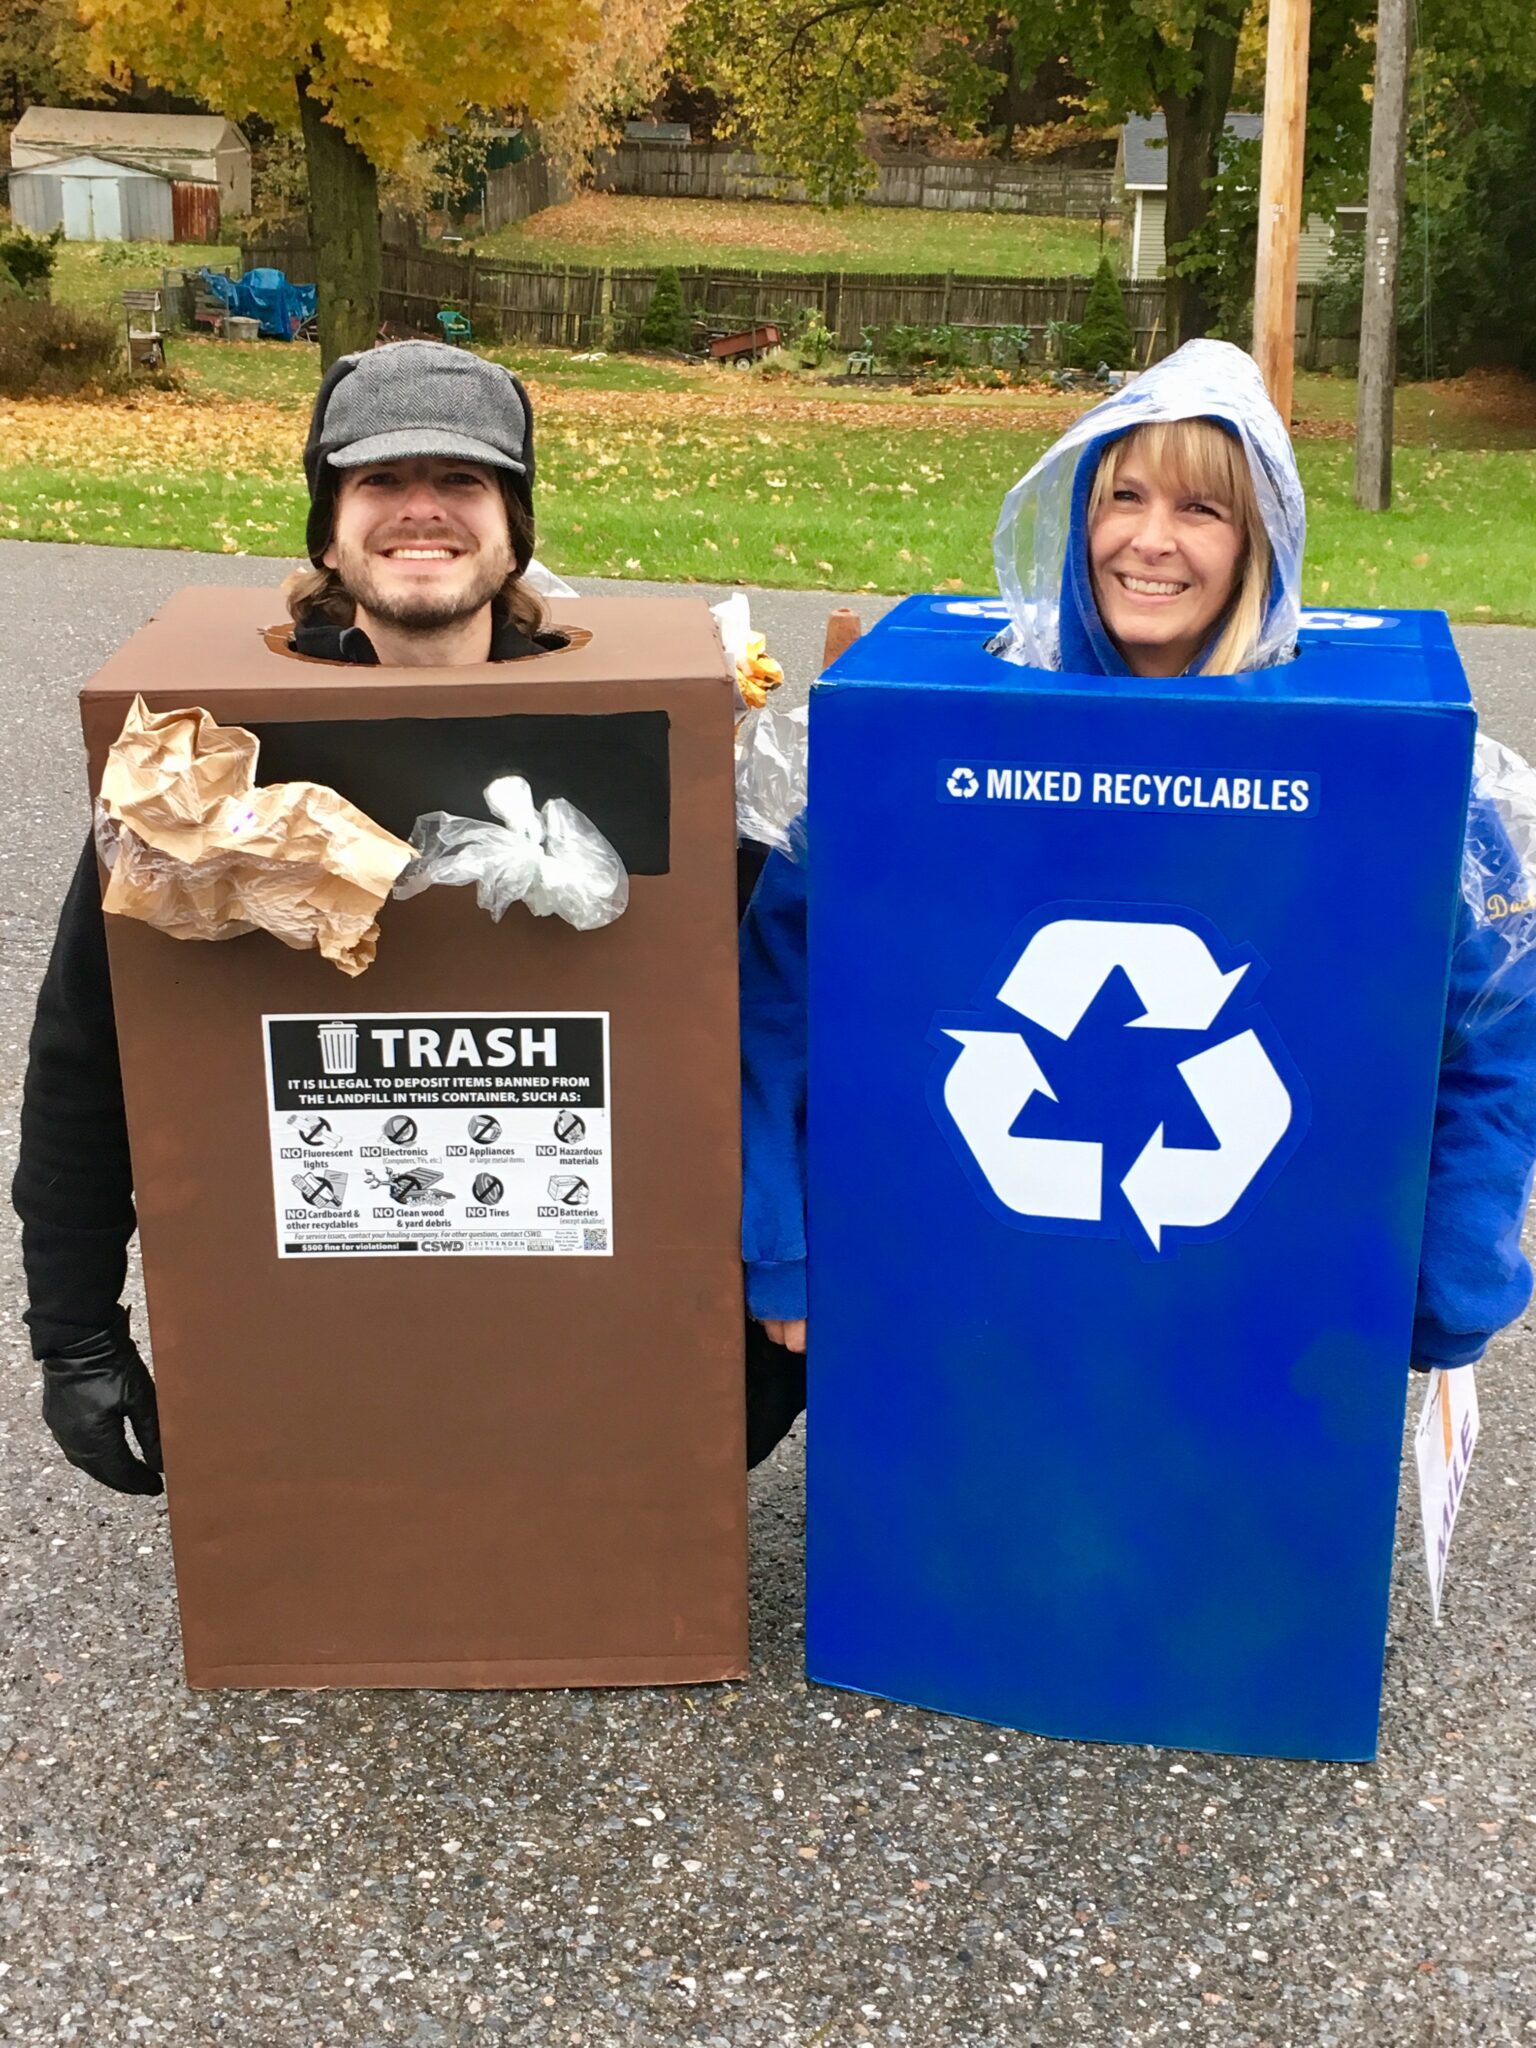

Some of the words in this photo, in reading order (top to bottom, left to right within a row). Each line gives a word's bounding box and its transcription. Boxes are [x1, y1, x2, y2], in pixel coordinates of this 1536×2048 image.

[986, 768, 1082, 803] MIXED
[1092, 773, 1310, 812] RECYCLABLES
[371, 1028, 557, 1068] TRASH
[288, 1079, 300, 1090] IT
[303, 1079, 316, 1090] IS
[318, 1078, 372, 1089] ILLEGAL
[374, 1078, 392, 1089] TO
[394, 1077, 450, 1088] DEPOSIT
[452, 1077, 493, 1088] ITEMS
[495, 1077, 550, 1087] BANNED
[552, 1076, 590, 1087] FROM
[299, 1094, 325, 1105] THE
[327, 1093, 391, 1104] LANDFILL
[393, 1093, 407, 1103] IN
[409, 1092, 440, 1103] THIS
[442, 1092, 520, 1103] CONTAINER,
[522, 1092, 557, 1102] SUCH
[559, 1092, 581, 1102] AS:
[282, 1148, 301, 1158] NO
[303, 1149, 353, 1158] Fluorescent
[361, 1147, 380, 1157] NO
[382, 1147, 428, 1157] Electronics
[447, 1146, 467, 1156] NO
[469, 1146, 515, 1157] Appliances
[536, 1146, 556, 1156] NO
[559, 1147, 603, 1156] Hazardous
[303, 1161, 329, 1170] lights
[559, 1157, 599, 1165] materials
[286, 1209, 306, 1219] NO
[308, 1210, 351, 1218] Cardboard
[353, 1210, 360, 1218] &
[373, 1208, 394, 1218] NO
[396, 1208, 420, 1217] Clean
[421, 1208, 444, 1217] wood
[466, 1207, 486, 1217] NO
[489, 1208, 510, 1217] Tires
[538, 1207, 558, 1217] NO
[560, 1208, 598, 1217] Batteries
[286, 1221, 310, 1230] other
[311, 1220, 358, 1230] recyclables
[396, 1220, 404, 1228] &
[405, 1219, 424, 1229] yard
[425, 1219, 452, 1228] debris
[386, 1231, 410, 1239] hauling
[451, 1230, 468, 1238] other
[500, 1230, 523, 1238] contact
[302, 1243, 323, 1251] $500
[324, 1242, 343, 1250] fine
[344, 1242, 355, 1250] for
[355, 1242, 400, 1250] violations!
[421, 1241, 464, 1252] CSWD
